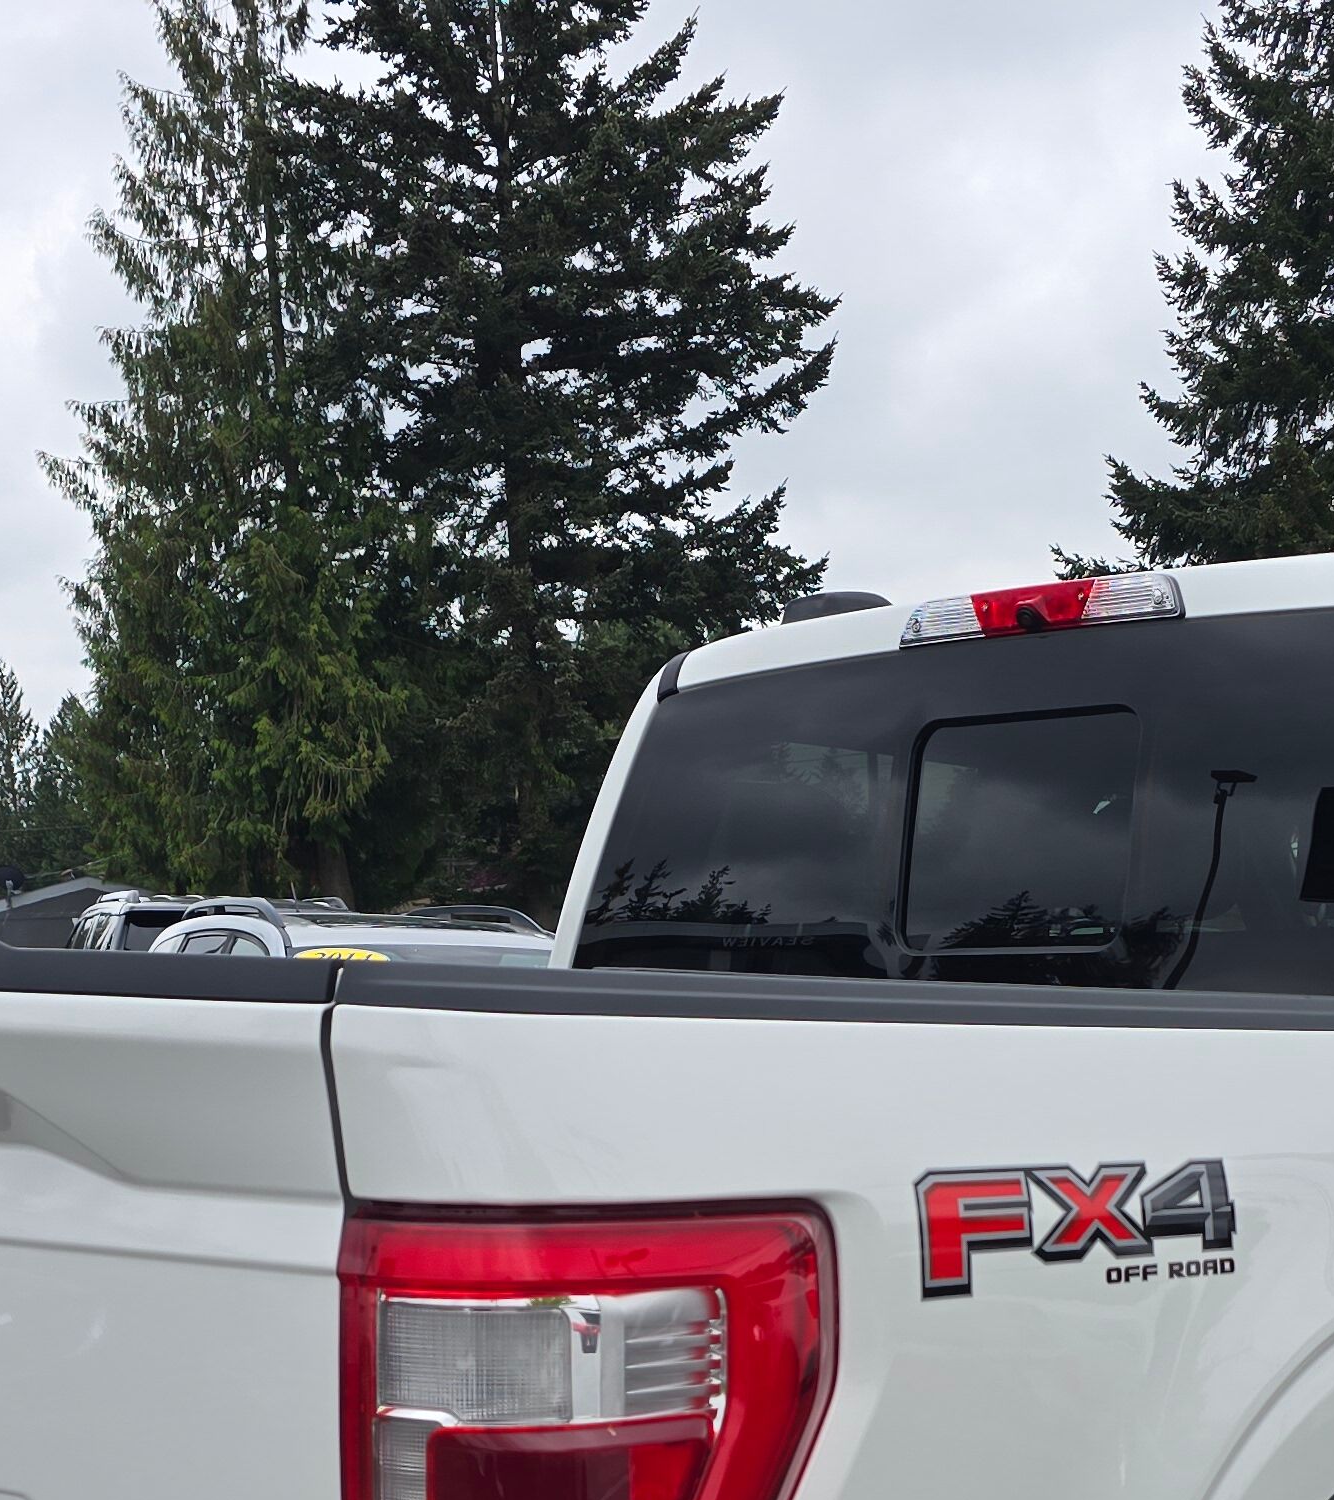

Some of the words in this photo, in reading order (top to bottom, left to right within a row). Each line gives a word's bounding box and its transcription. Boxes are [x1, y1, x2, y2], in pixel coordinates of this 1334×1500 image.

[913, 1157, 1236, 1301] FX4
[1105, 1263, 1158, 1285] OFF
[1168, 1256, 1235, 1280] ROAD
